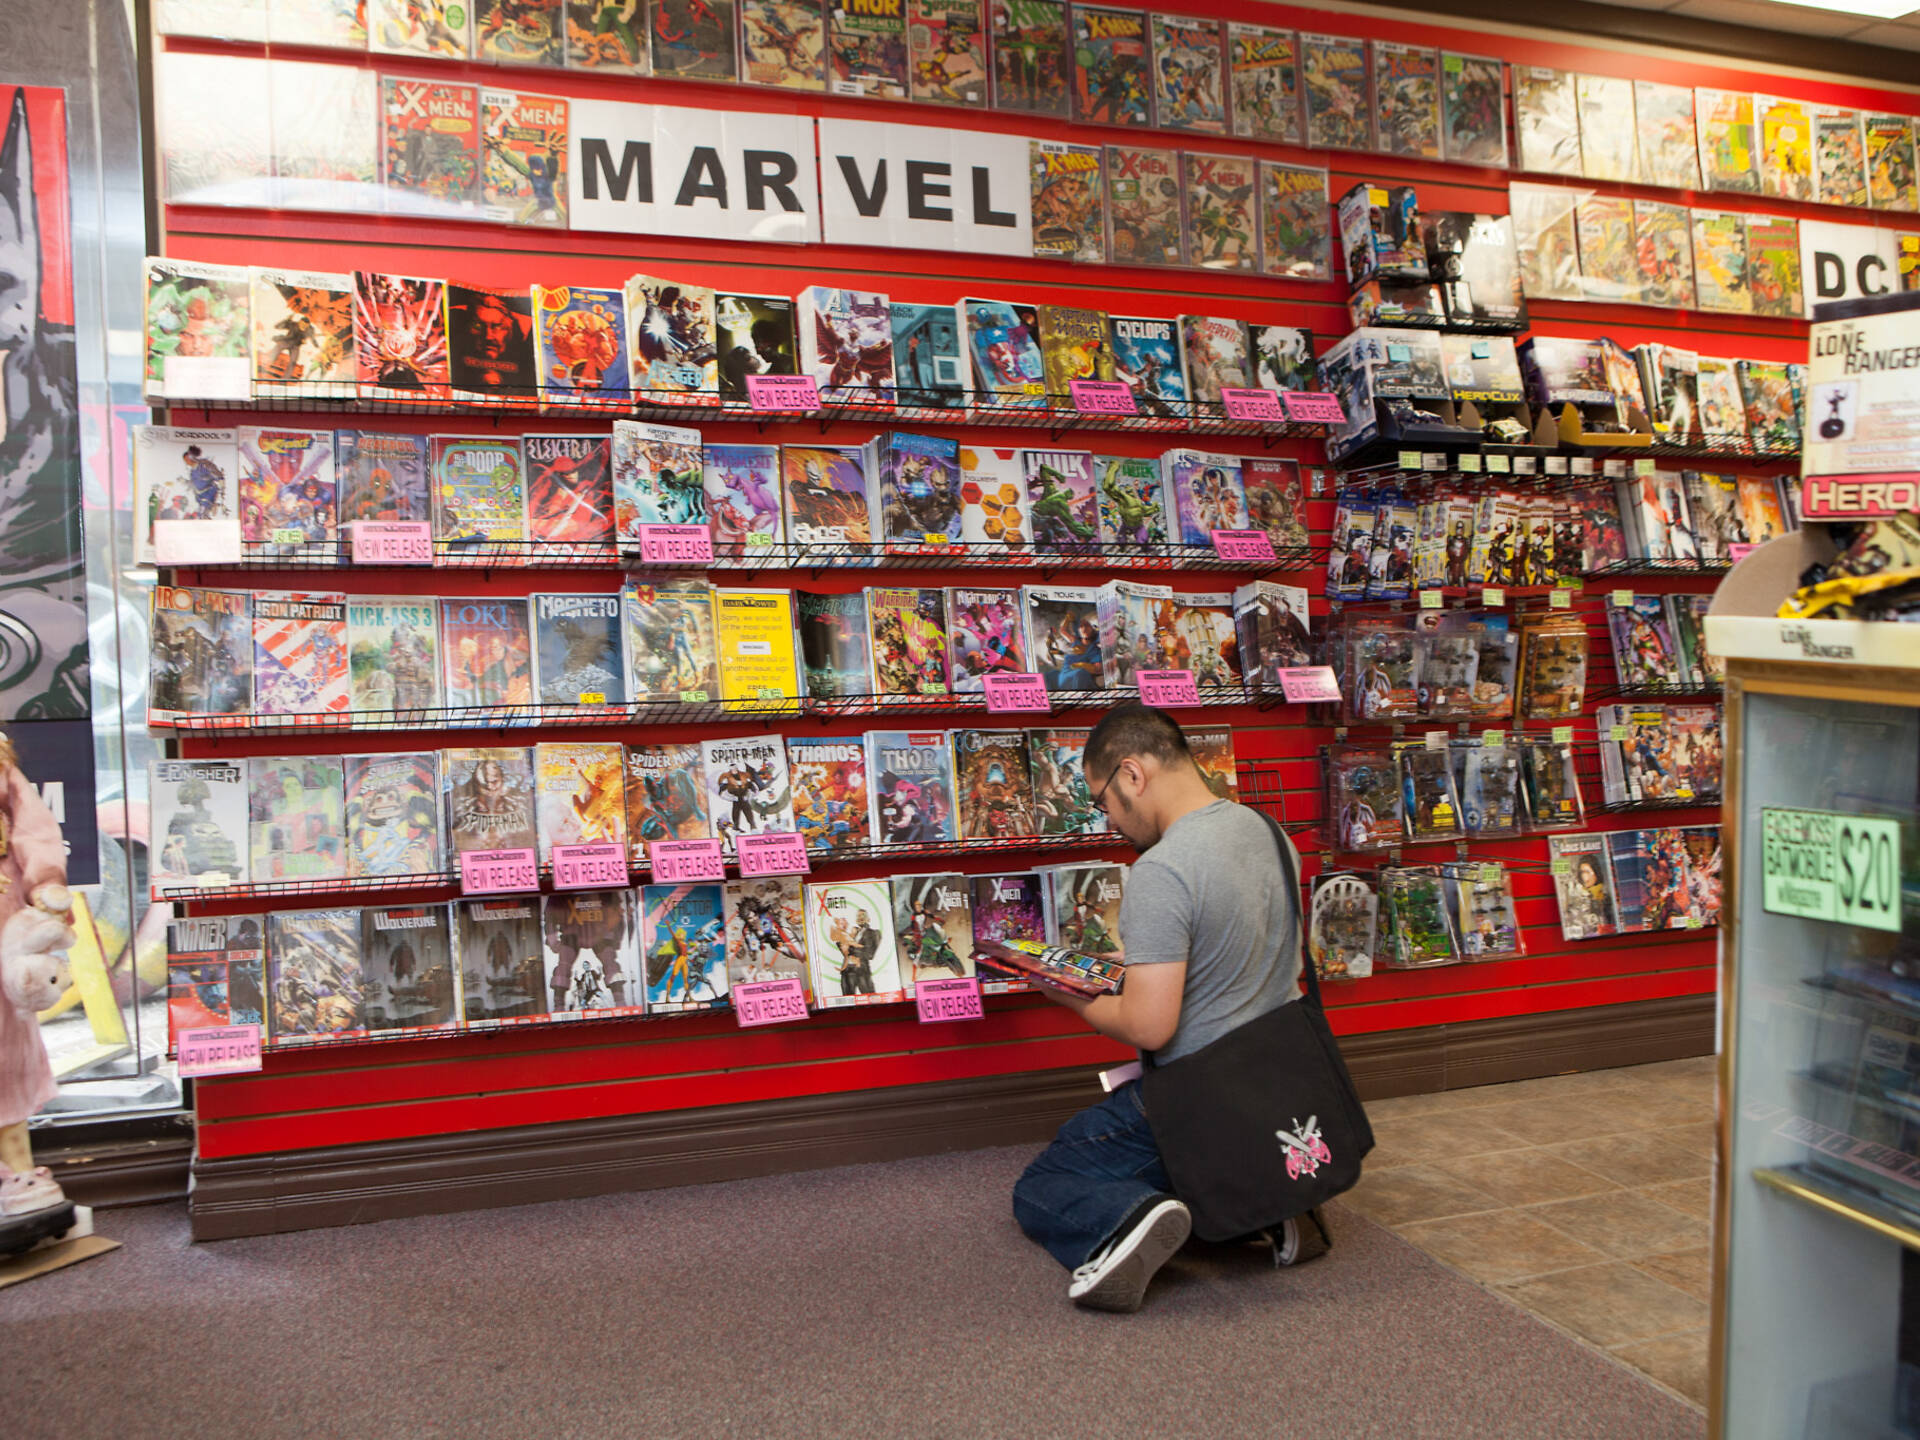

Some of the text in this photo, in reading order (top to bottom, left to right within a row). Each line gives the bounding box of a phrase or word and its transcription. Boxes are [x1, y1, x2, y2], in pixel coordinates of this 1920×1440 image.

[1085, 14, 1143, 41] X-MEN
[399, 84, 468, 118] X-MEN
[490, 104, 560, 128] X-MEN
[1043, 152, 1099, 176] X-MEN
[1118, 151, 1169, 180] X-MEN
[1195, 159, 1245, 186] X-MEN
[580, 137, 1017, 228] MARVEL
[1272, 170, 1324, 194] X-MEN
[1814, 250, 1889, 298] DC
[1115, 320, 1171, 340] CYCLOPS
[1816, 331, 1866, 357] LONE
[752, 389, 819, 408] NEW RELEASE
[1076, 394, 1135, 411] NEW RELEASE
[1453, 390, 1520, 403] HEROCLIX
[526, 438, 592, 461] ELEKTRA
[465, 451, 504, 473] DOOP
[1026, 453, 1089, 480] HULK
[1121, 464, 1155, 478] HULK
[1811, 482, 1920, 513] HERO
[645, 540, 711, 560] NEW RELEASE
[255, 601, 342, 619] IRON PATRIOT
[540, 596, 619, 620] MAGNETO
[874, 590, 918, 609] WARRIORS
[350, 606, 433, 627] KICK-ASS 3
[442, 603, 511, 631] LOKI
[990, 688, 1050, 710] NEW RELEASE
[711, 746, 776, 764] SPIDER-MAN
[790, 744, 863, 763] THANOS
[881, 748, 938, 771] THOR
[166, 763, 241, 784] PUNISHER
[460, 810, 530, 833] SPIDER-MAN
[655, 856, 724, 879] NEW RELEASE
[739, 849, 807, 873] NEW RELEASE
[1839, 823, 1893, 916] $20
[465, 866, 536, 889] NEW RELEASE
[556, 861, 626, 885] NEW RELEASE
[373, 911, 438, 930] WOLVERINE
[470, 902, 532, 922] WOLVERINE
[741, 995, 807, 1022] NEW RELEASE
[920, 996, 981, 1019] NEW RELEASE
